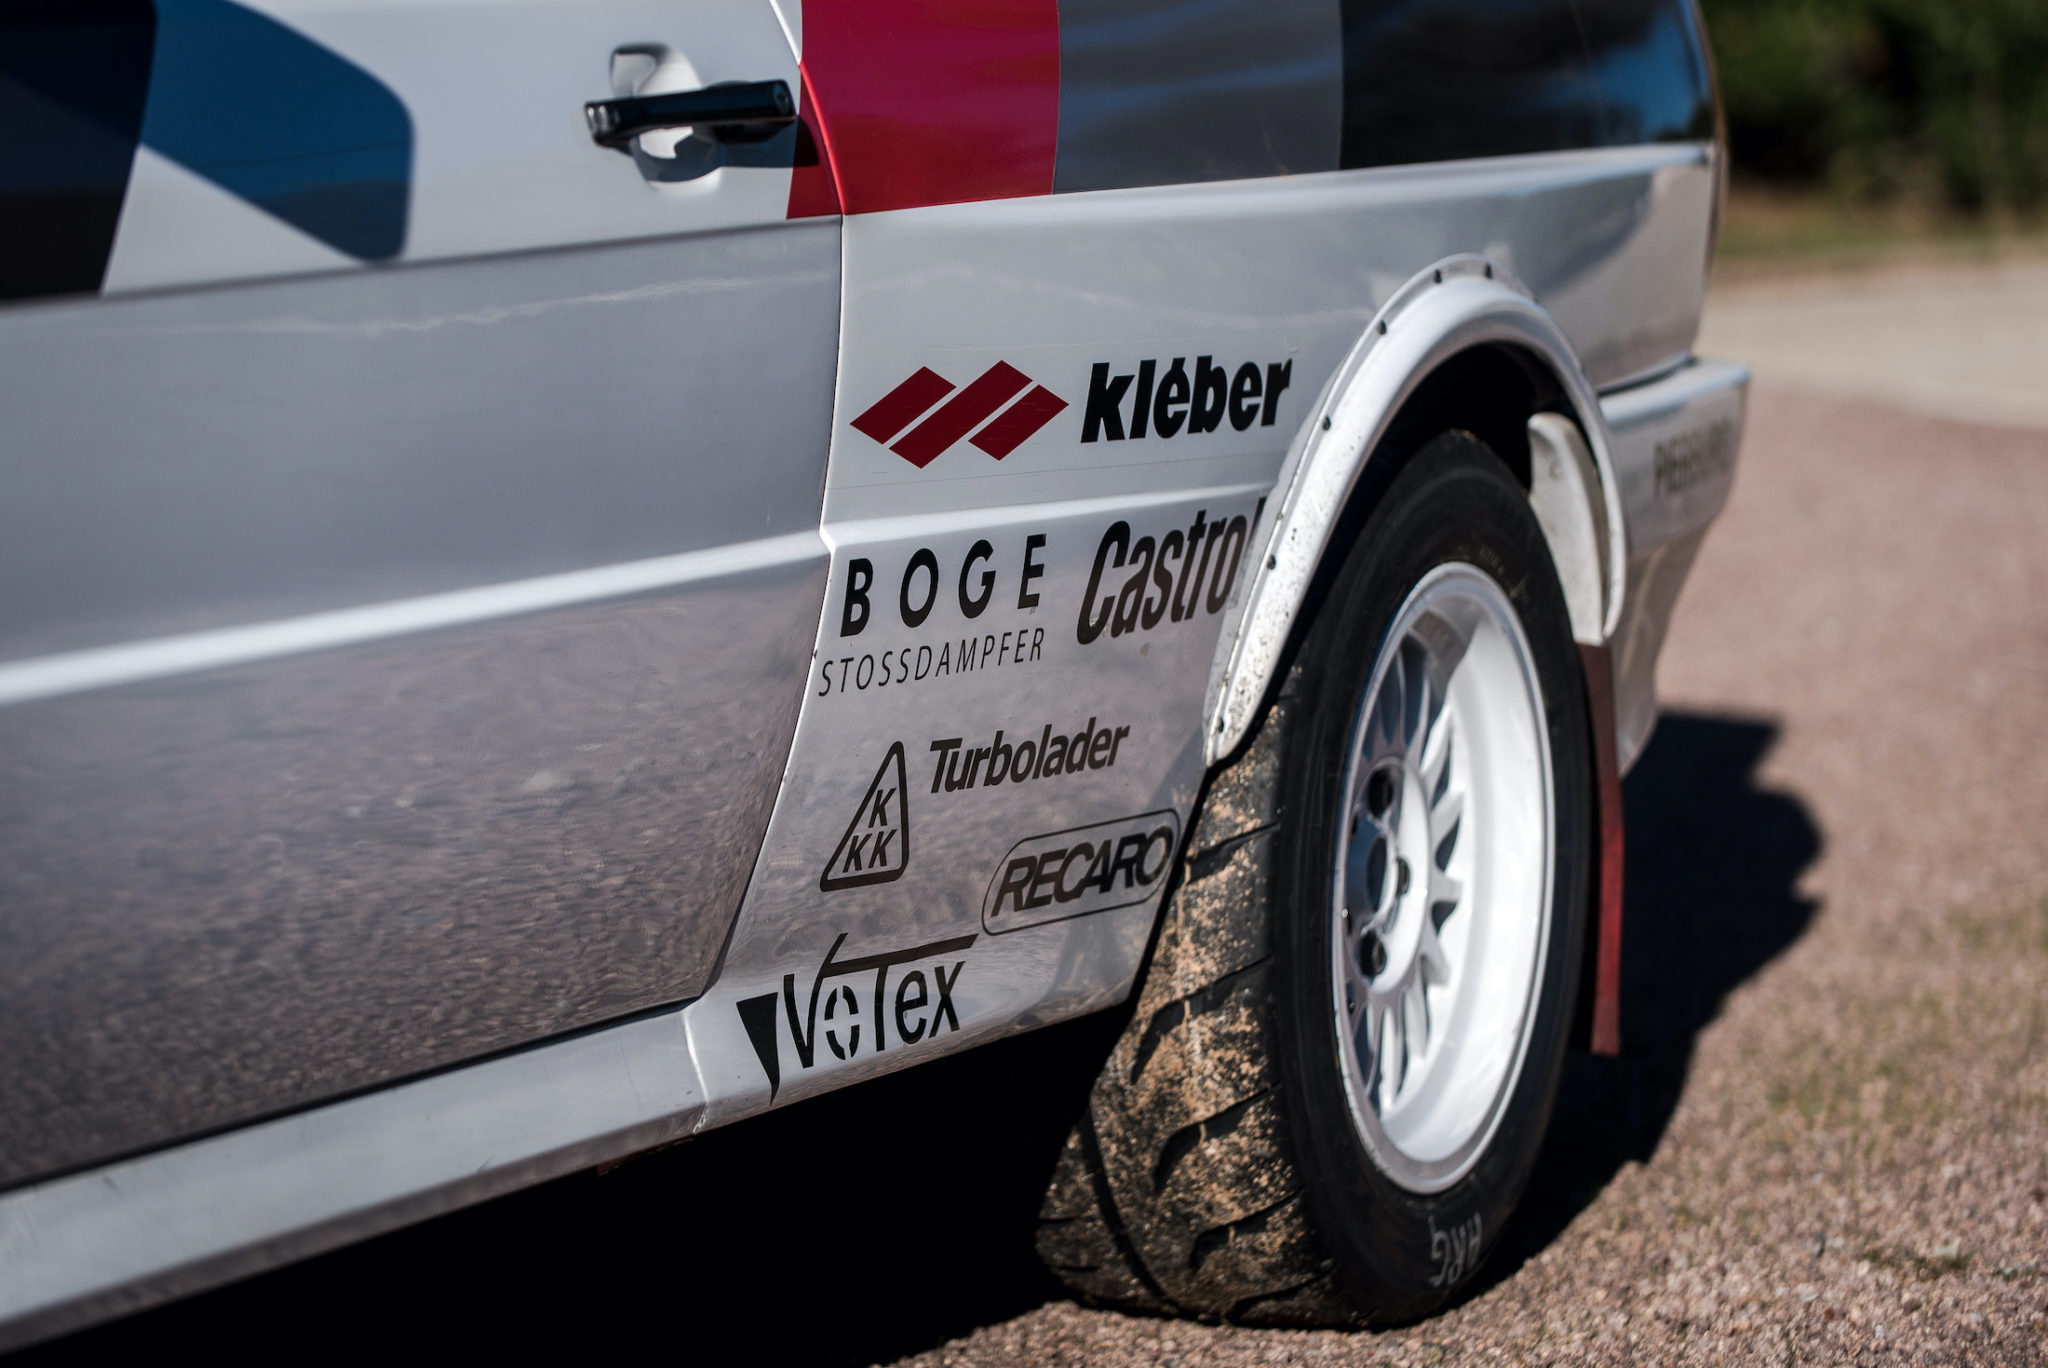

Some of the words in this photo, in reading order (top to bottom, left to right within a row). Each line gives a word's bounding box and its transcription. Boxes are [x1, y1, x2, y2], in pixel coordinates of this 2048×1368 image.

[1080, 355, 1293, 443] kléber
[840, 533, 1047, 637] BOGE
[818, 627, 1046, 697] STOSSDAMPFER
[930, 717, 1130, 794] Turbolader
[870, 788, 897, 827] K
[843, 829, 898, 872] KK
[990, 824, 1174, 917] RECARO
